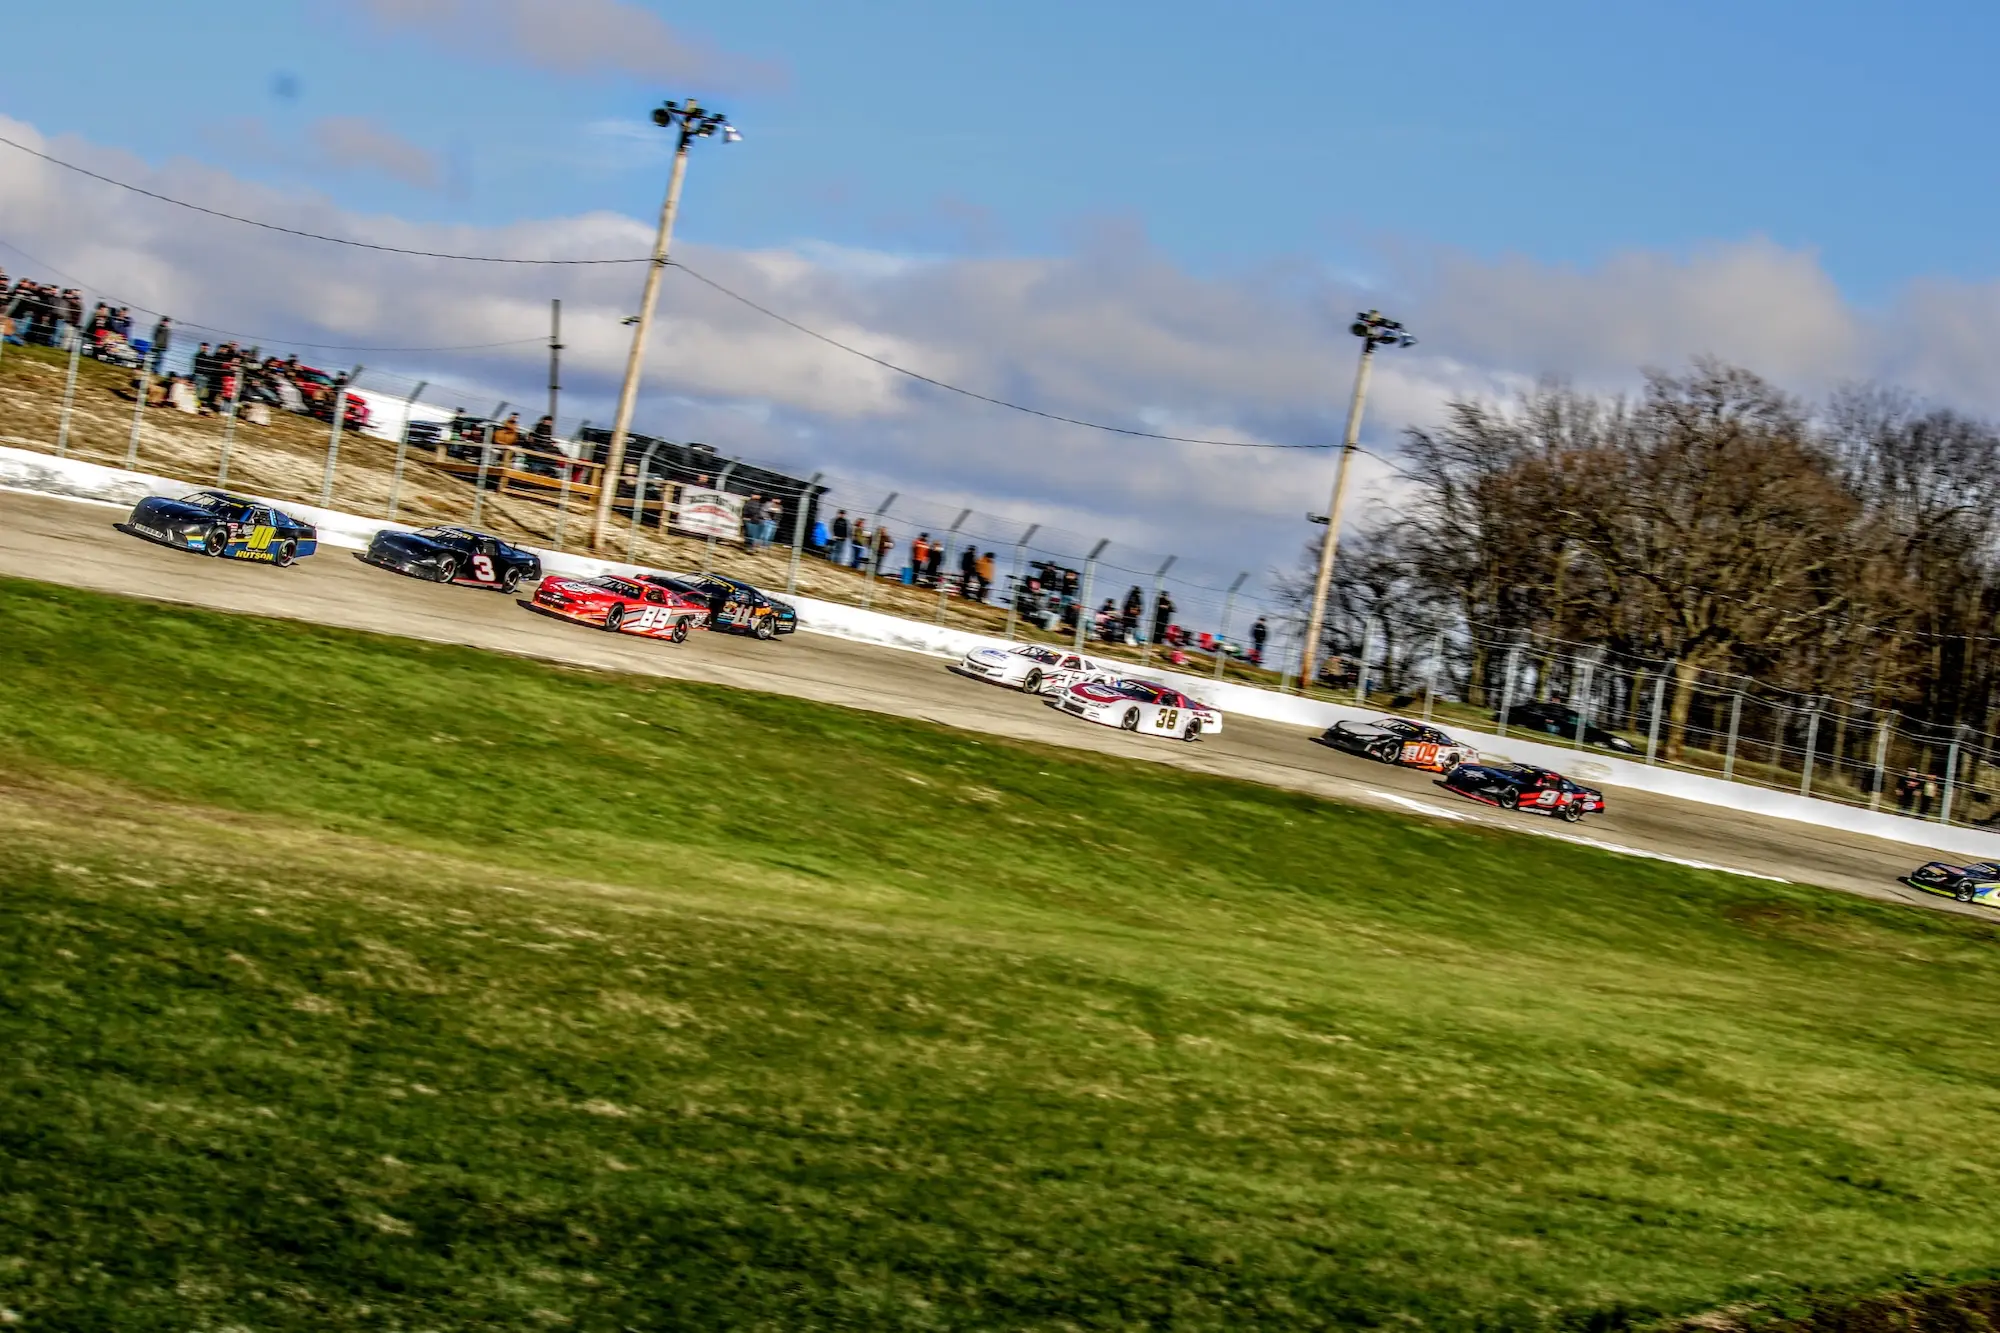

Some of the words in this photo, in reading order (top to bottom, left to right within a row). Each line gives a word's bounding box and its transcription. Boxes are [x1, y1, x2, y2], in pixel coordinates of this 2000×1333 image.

[235, 550, 274, 560] HUTSON
[473, 555, 496, 581] 3
[1156, 708, 1178, 730] 38
[1416, 741, 1440, 765] 09
[1536, 789, 1560, 805] 9
